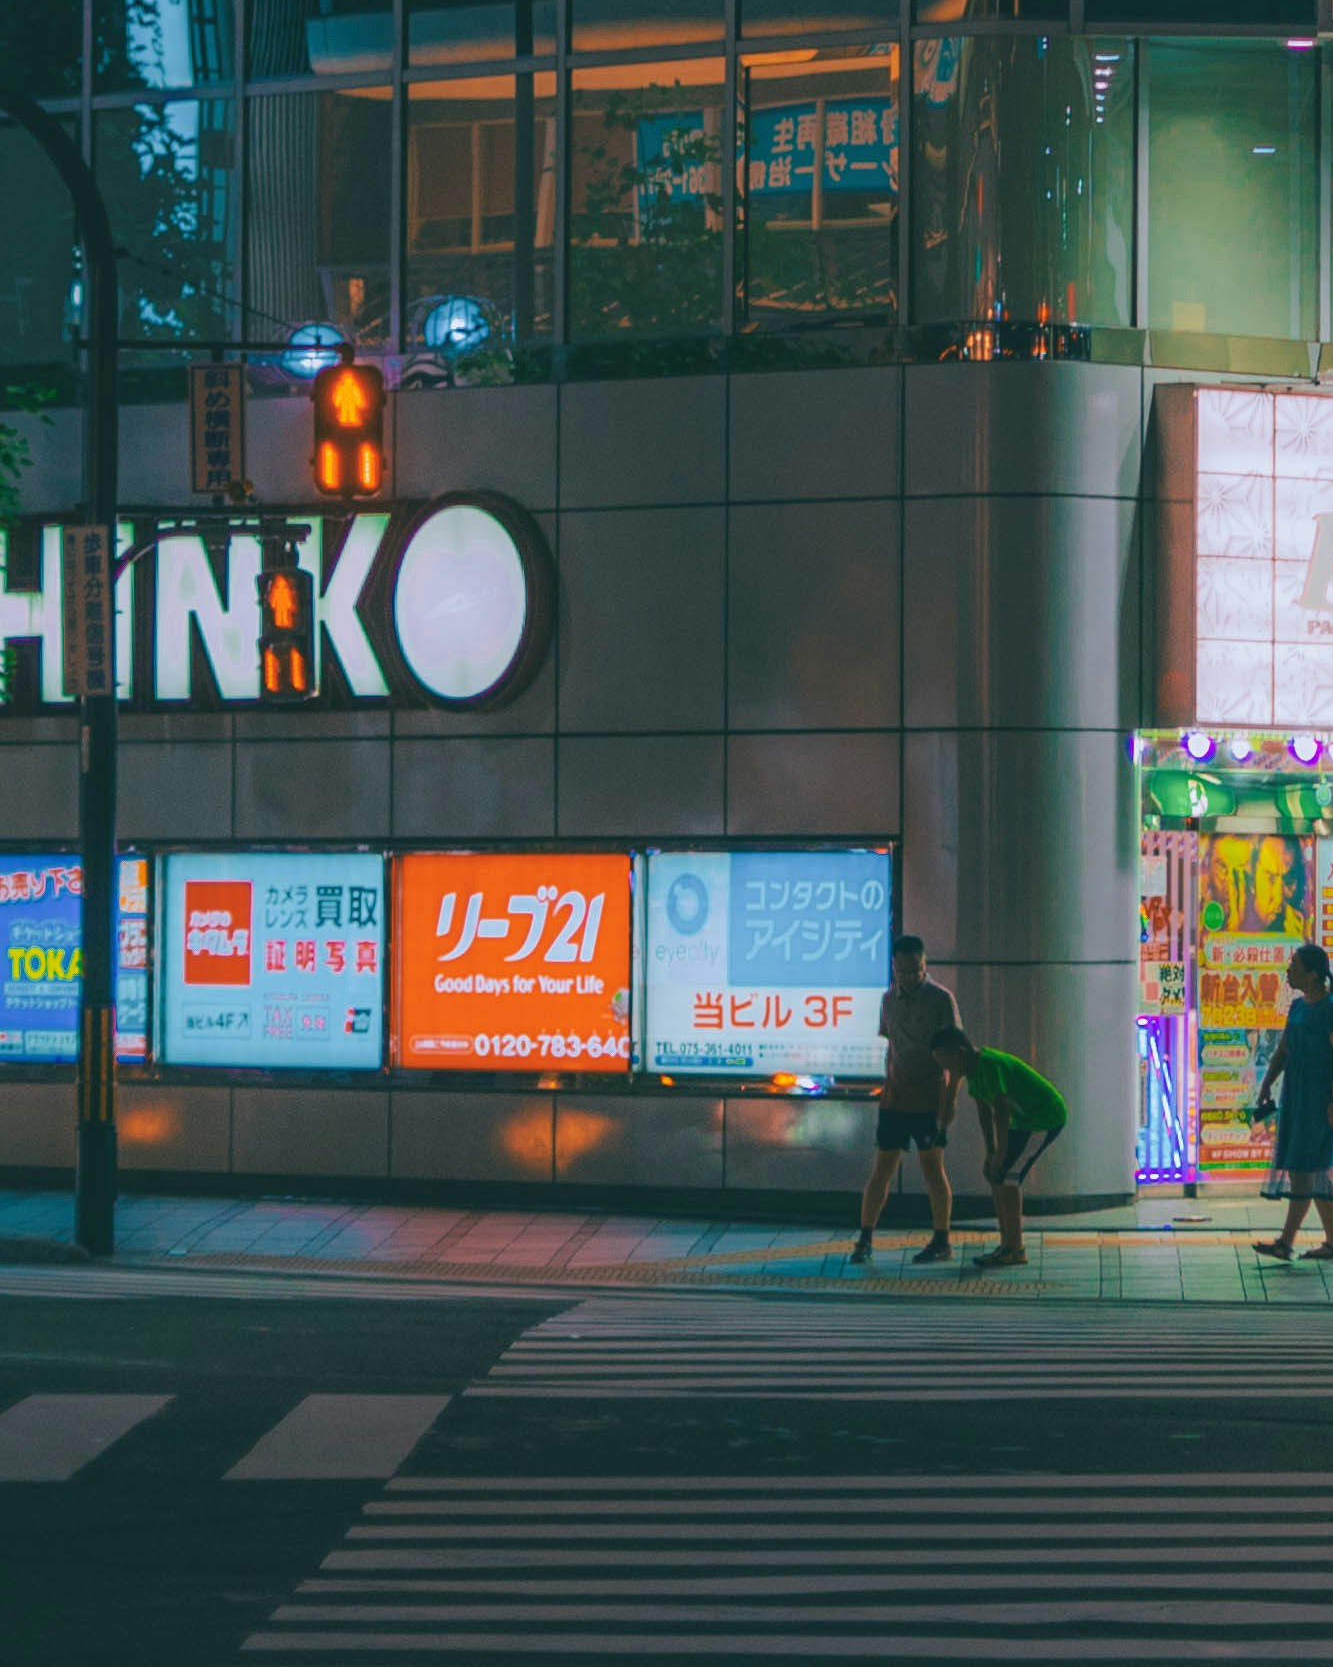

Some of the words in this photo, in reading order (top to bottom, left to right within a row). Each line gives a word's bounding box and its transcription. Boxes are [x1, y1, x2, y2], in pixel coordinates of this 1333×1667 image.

[265, 885, 310, 906] カメラ
[315, 884, 379, 929] 買取
[746, 879, 885, 909] コンタクトの
[264, 910, 310, 930] レンズ
[435, 884, 606, 964] リーブ21
[265, 940, 379, 974] 証明写真
[745, 917, 884, 963] アイシティ
[434, 973, 474, 995] Good
[475, 973, 510, 998] Days
[512, 973, 535, 995] for
[537, 974, 574, 995] Your
[576, 974, 605, 995] Life
[693, 991, 792, 1030] 当ビル
[803, 995, 854, 1029] 3F
